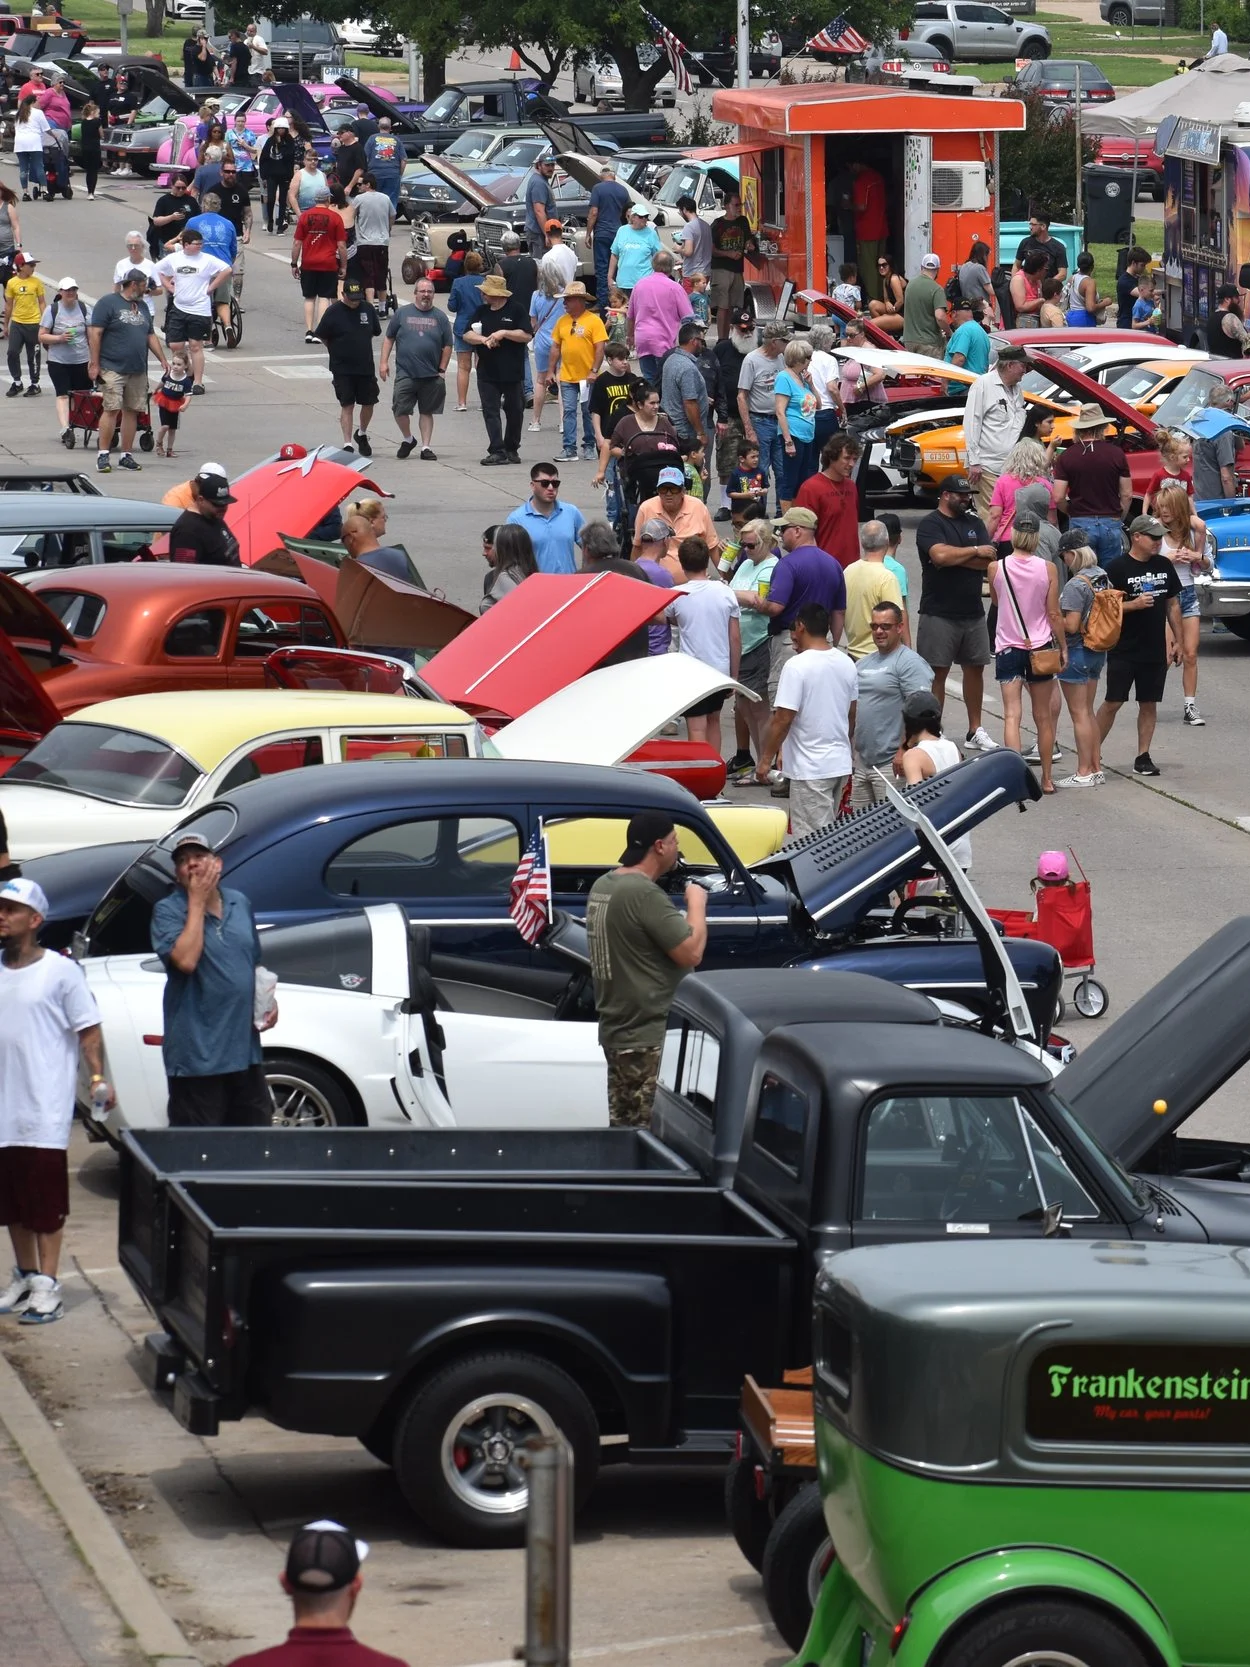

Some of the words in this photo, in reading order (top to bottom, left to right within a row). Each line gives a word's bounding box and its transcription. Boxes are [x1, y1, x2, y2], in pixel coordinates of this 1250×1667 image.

[605, 384, 630, 399] NIRVA
[929, 453, 951, 461] GT350
[1094, 1405, 1117, 1420] My
[1144, 1409, 1171, 1421] your
